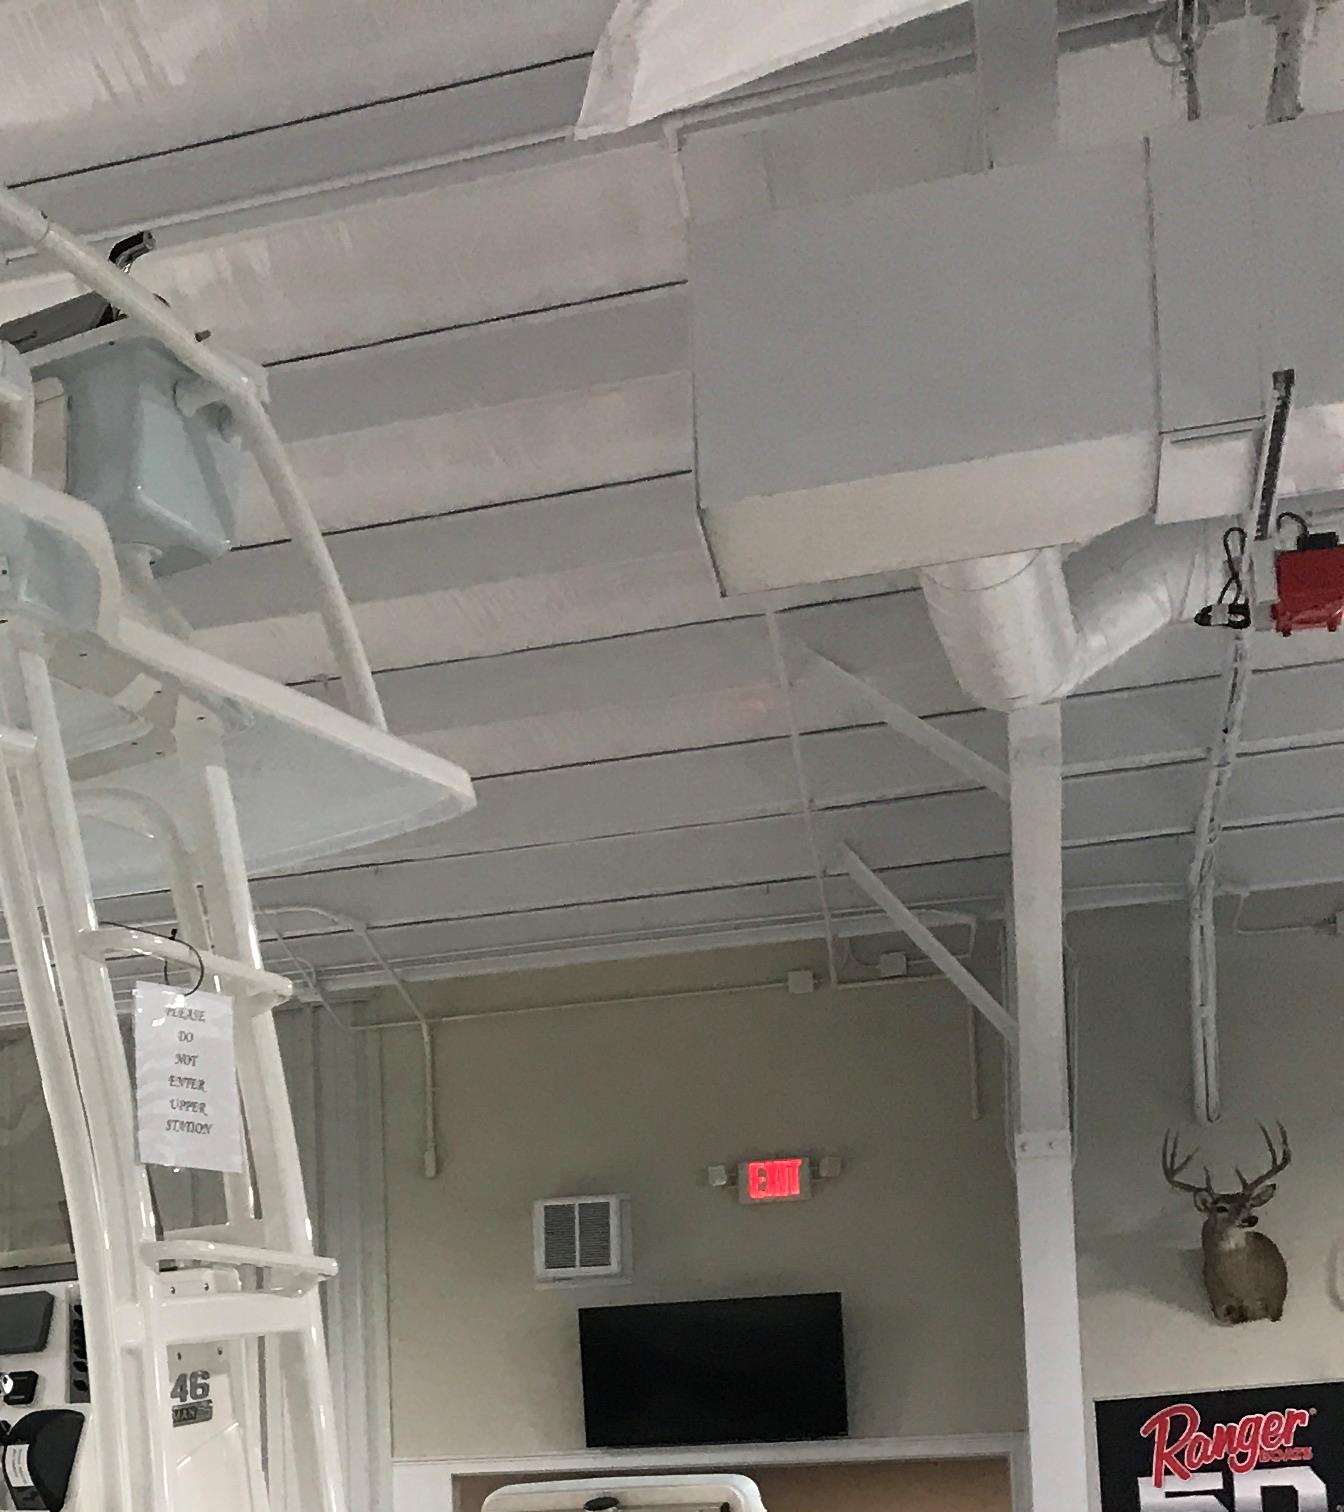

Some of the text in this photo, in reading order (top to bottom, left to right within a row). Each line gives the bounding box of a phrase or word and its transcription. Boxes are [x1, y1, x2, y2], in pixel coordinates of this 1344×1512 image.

[166, 1007, 206, 1023] PLEASE
[177, 1030, 194, 1042] DO
[174, 1053, 198, 1067] NOT
[168, 1075, 207, 1093] ENTER
[169, 1099, 208, 1116] UPPER
[165, 1119, 213, 1135] STATION
[748, 1159, 802, 1199] EXIT
[1140, 1403, 1310, 1488] Ranger
